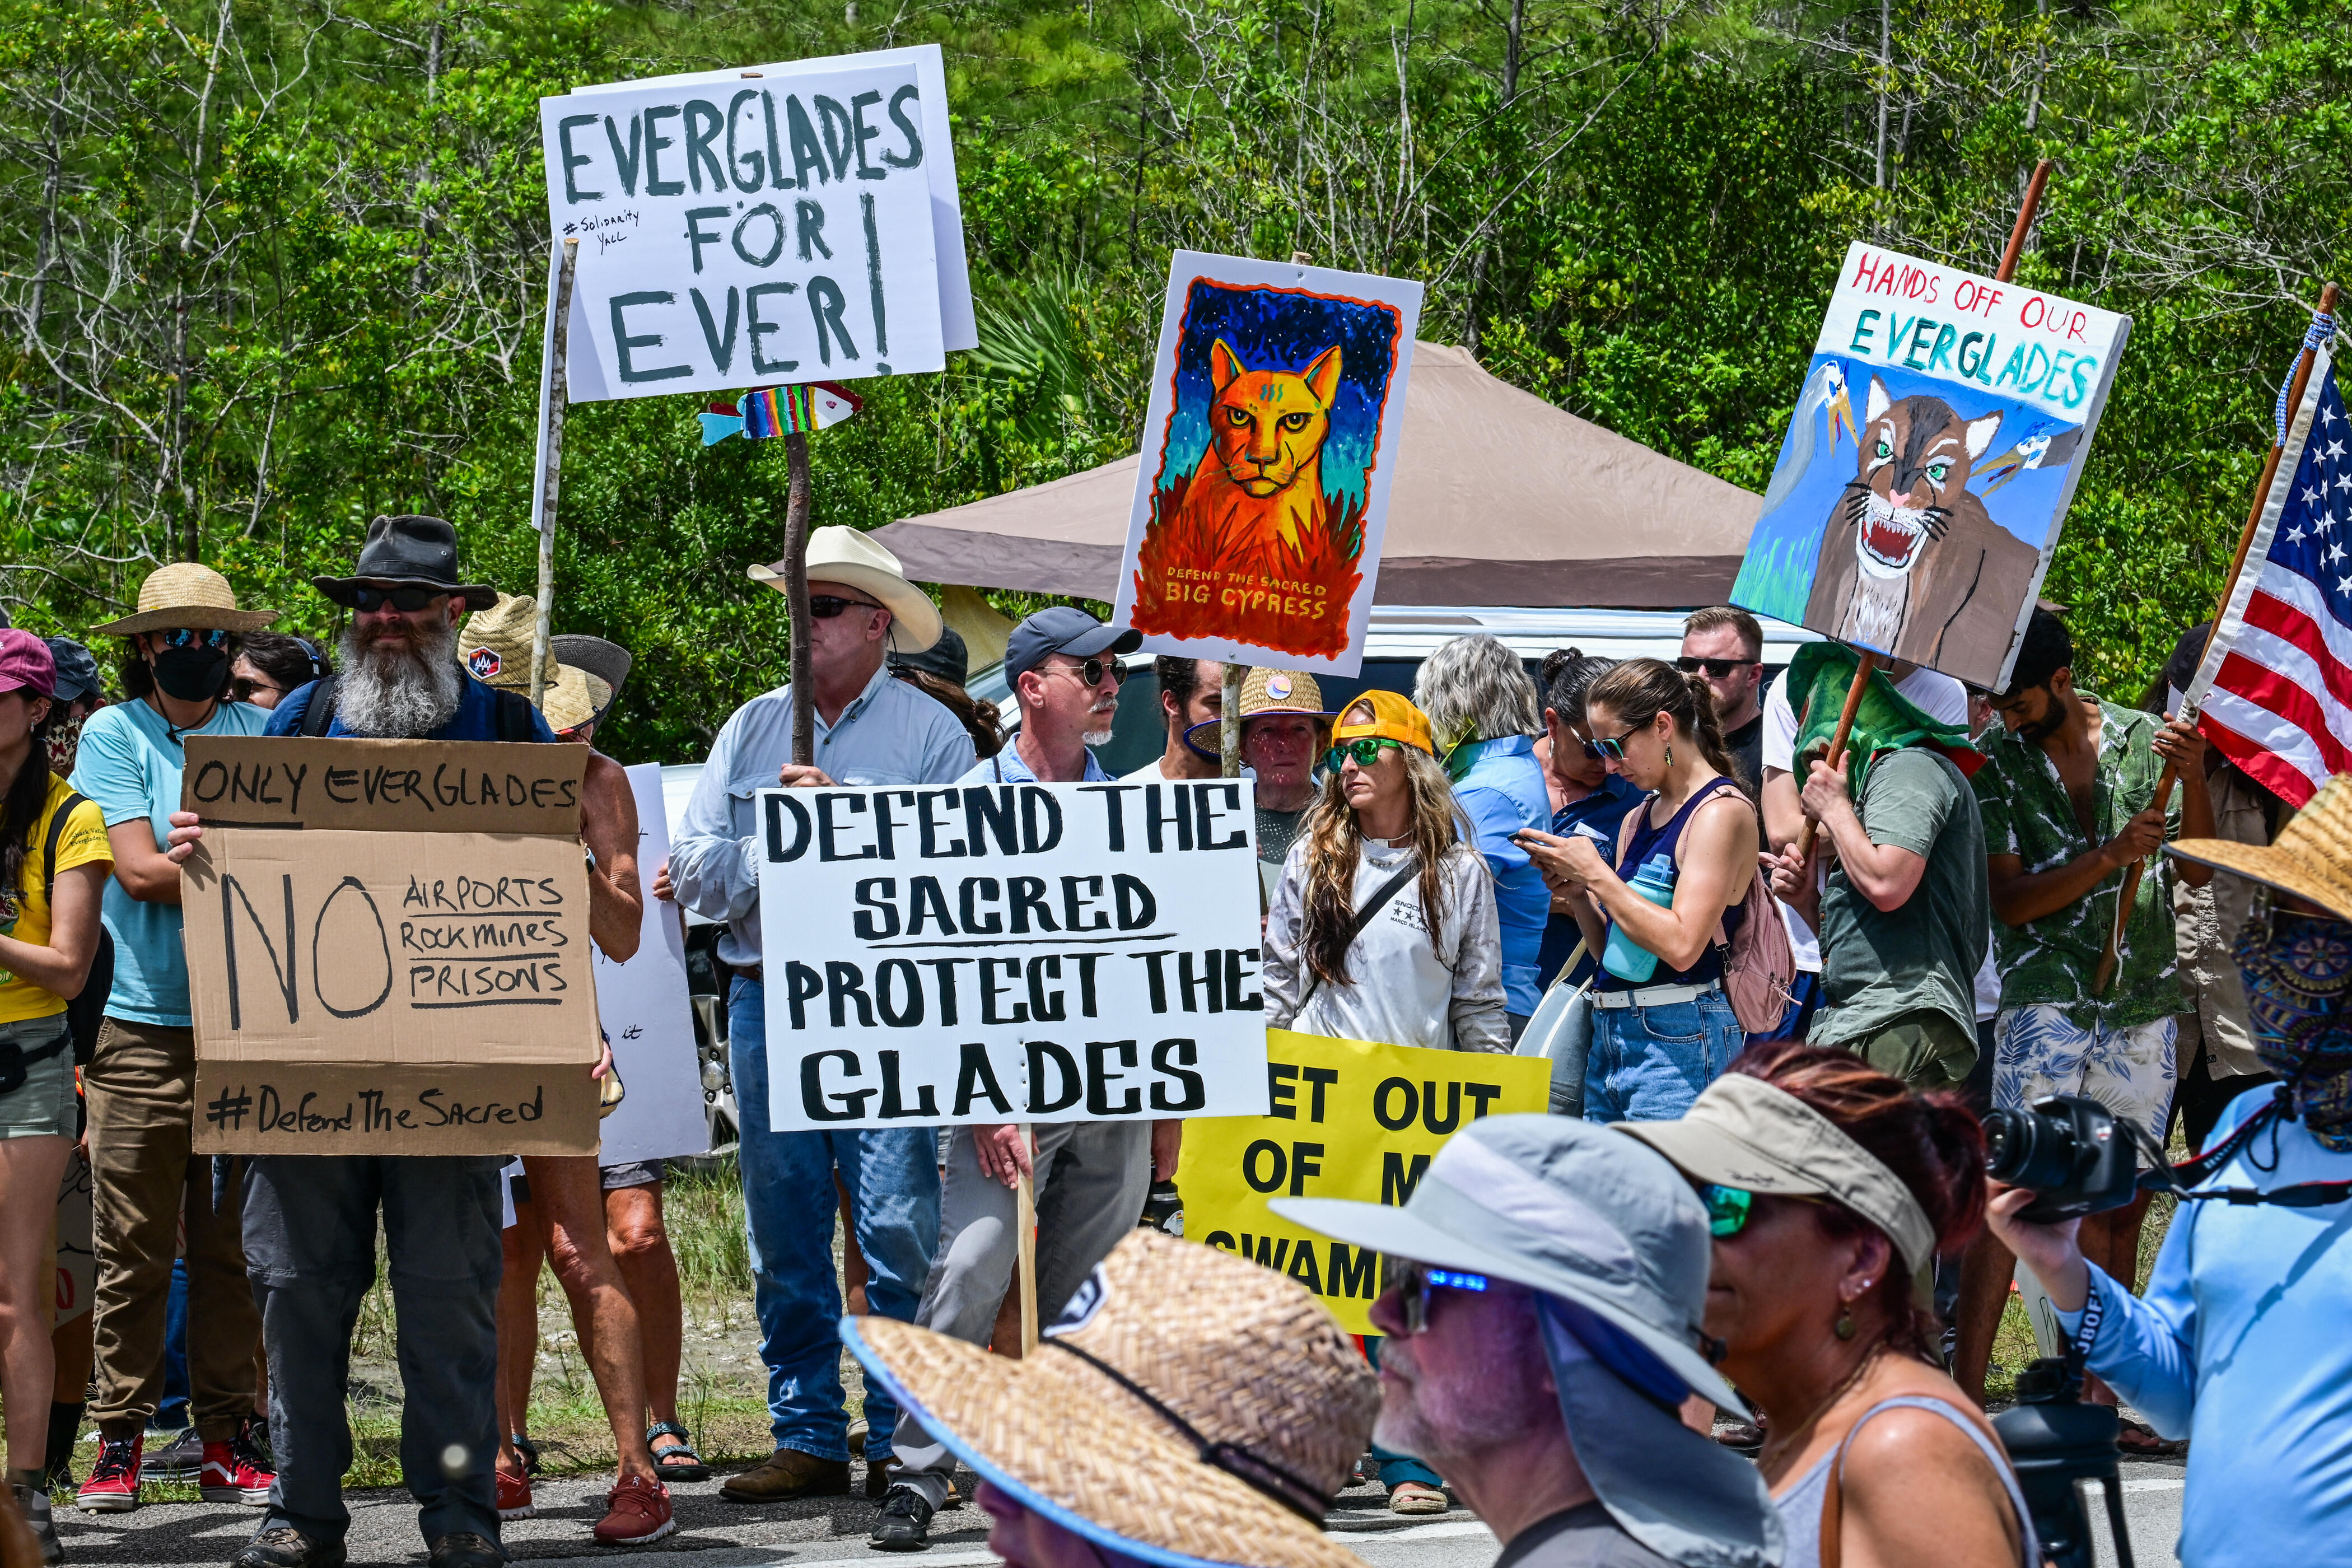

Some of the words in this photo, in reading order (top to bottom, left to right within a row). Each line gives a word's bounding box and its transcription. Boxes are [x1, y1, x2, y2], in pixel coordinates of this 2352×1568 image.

[558, 83, 923, 206] EVERGLADES
[684, 199, 833, 275] FOR
[1851, 251, 1940, 304] HANDS
[1954, 279, 2004, 318] OFF
[2019, 296, 2088, 344] OUR
[1849, 309, 2099, 409] EVERGLADES
[1165, 581, 1212, 604] BIG
[1220, 587, 1327, 620] CYPRESS
[1167, 566, 1221, 581] DEFEND
[1227, 572, 1254, 585] THE
[1261, 576, 1327, 596] SACRED
[193, 759, 307, 815] ONLY
[325, 762, 577, 813] EVERGLADES
[70, 836, 101, 847] Everglades
[71, 829, 90, 839] Shark
[90, 828, 106, 836] Valley
[764, 785, 1063, 863] DEFEND
[1076, 783, 1249, 853] THE
[853, 874, 1156, 941] SACRED
[1390, 916, 1408, 926] MARCO
[221, 873, 393, 1031] NO
[403, 874, 563, 912] AIRPORTS
[409, 963, 567, 997] PRISONS
[785, 952, 1114, 1030] PROTECT
[1126, 948, 1264, 1014] THE
[801, 1038, 1205, 1122] GLADES
[1268, 1062, 1338, 1123] ET
[1373, 1076, 1501, 1135] OUT
[1243, 1138, 1324, 1197] OF
[1381, 1151, 1431, 1207] M
